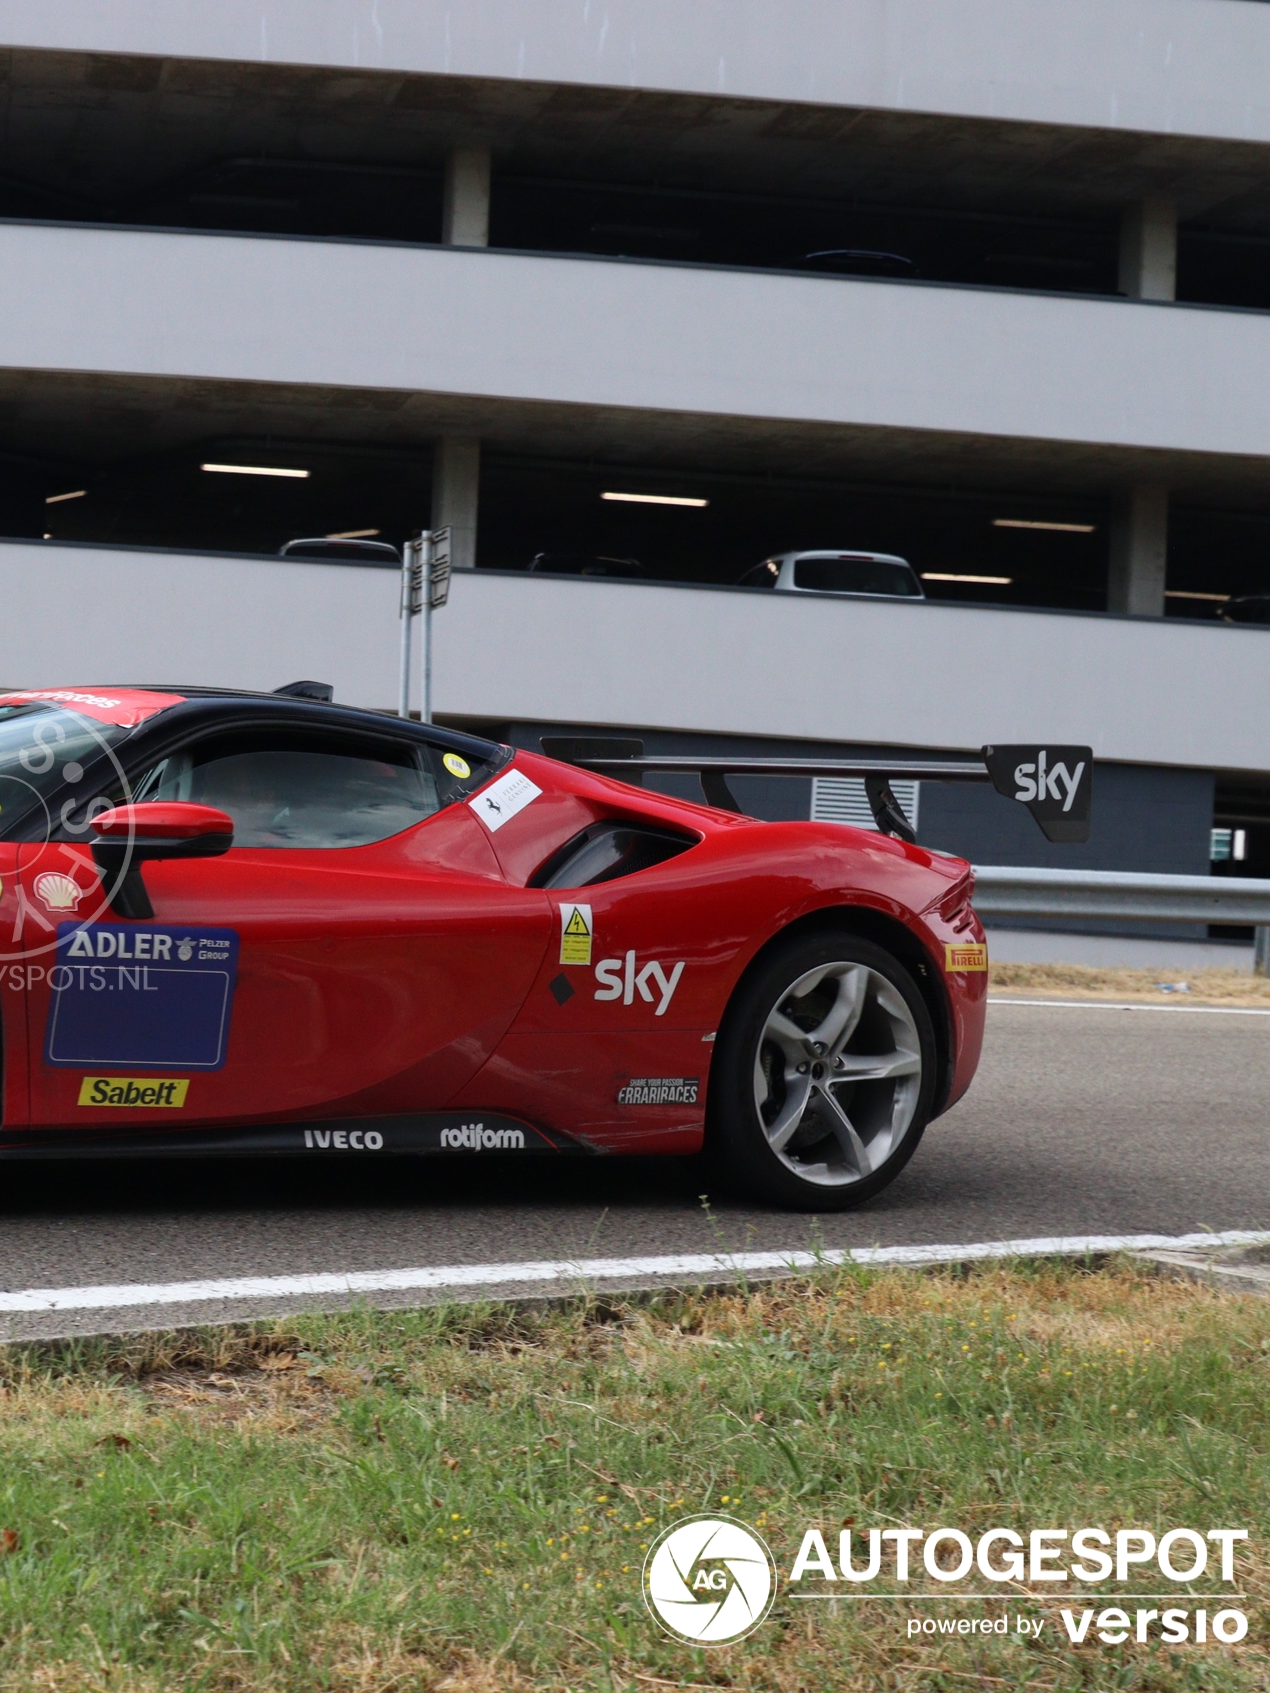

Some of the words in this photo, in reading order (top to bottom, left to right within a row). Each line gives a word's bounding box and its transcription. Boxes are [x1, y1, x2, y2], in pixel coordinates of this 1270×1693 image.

[502, 777, 526, 797] FERRARI
[508, 782, 532, 802] GENUINE
[1014, 750, 1086, 812] sky
[67, 931, 172, 960] ADLER
[951, 949, 984, 966] PIRELLI
[594, 950, 686, 1016] sky
[90, 1079, 177, 1105] Sabelt
[304, 1130, 384, 1149] IVECO
[440, 1123, 526, 1152] rotiform
